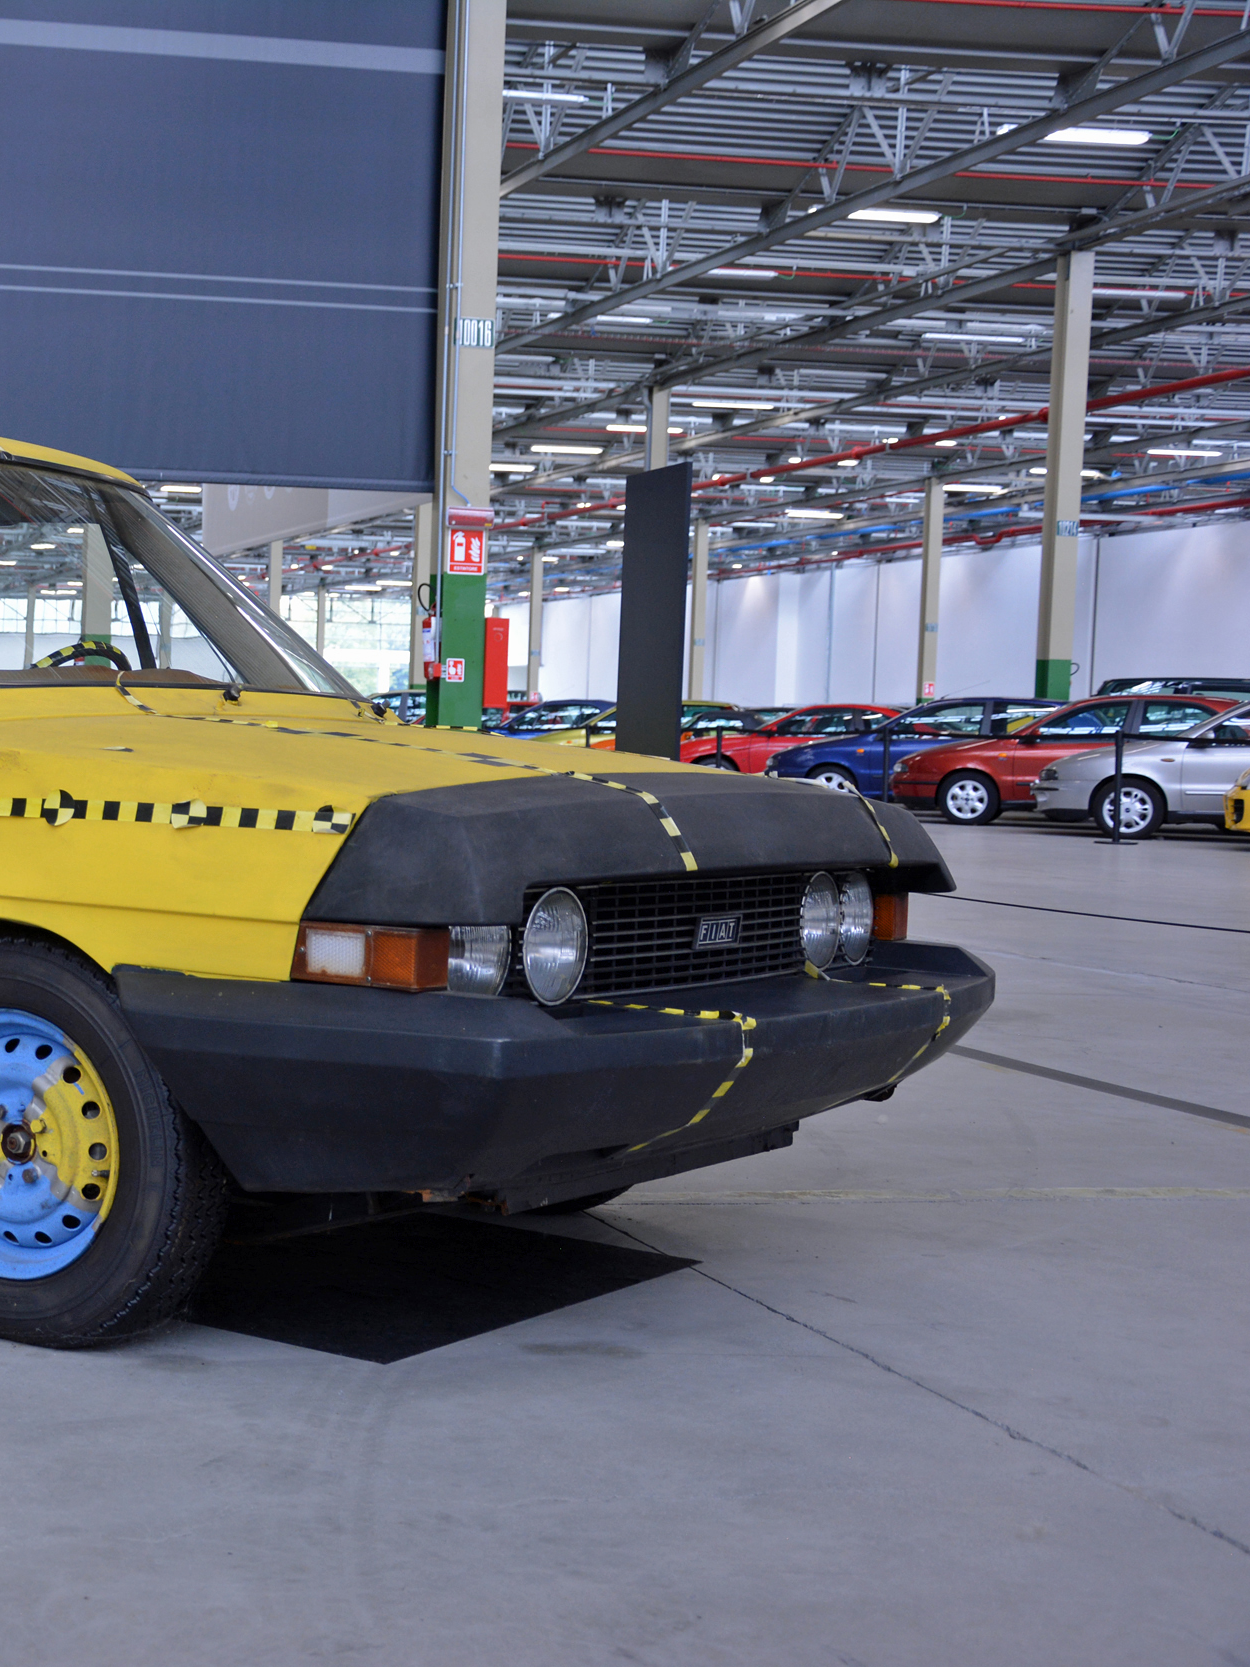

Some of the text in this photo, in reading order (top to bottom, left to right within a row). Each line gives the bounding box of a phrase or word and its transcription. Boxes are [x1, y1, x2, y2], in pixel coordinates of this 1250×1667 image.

[458, 319, 492, 347] 10016
[700, 922, 735, 940] FIAT
[135, 1069, 163, 1167] MICHELIN
